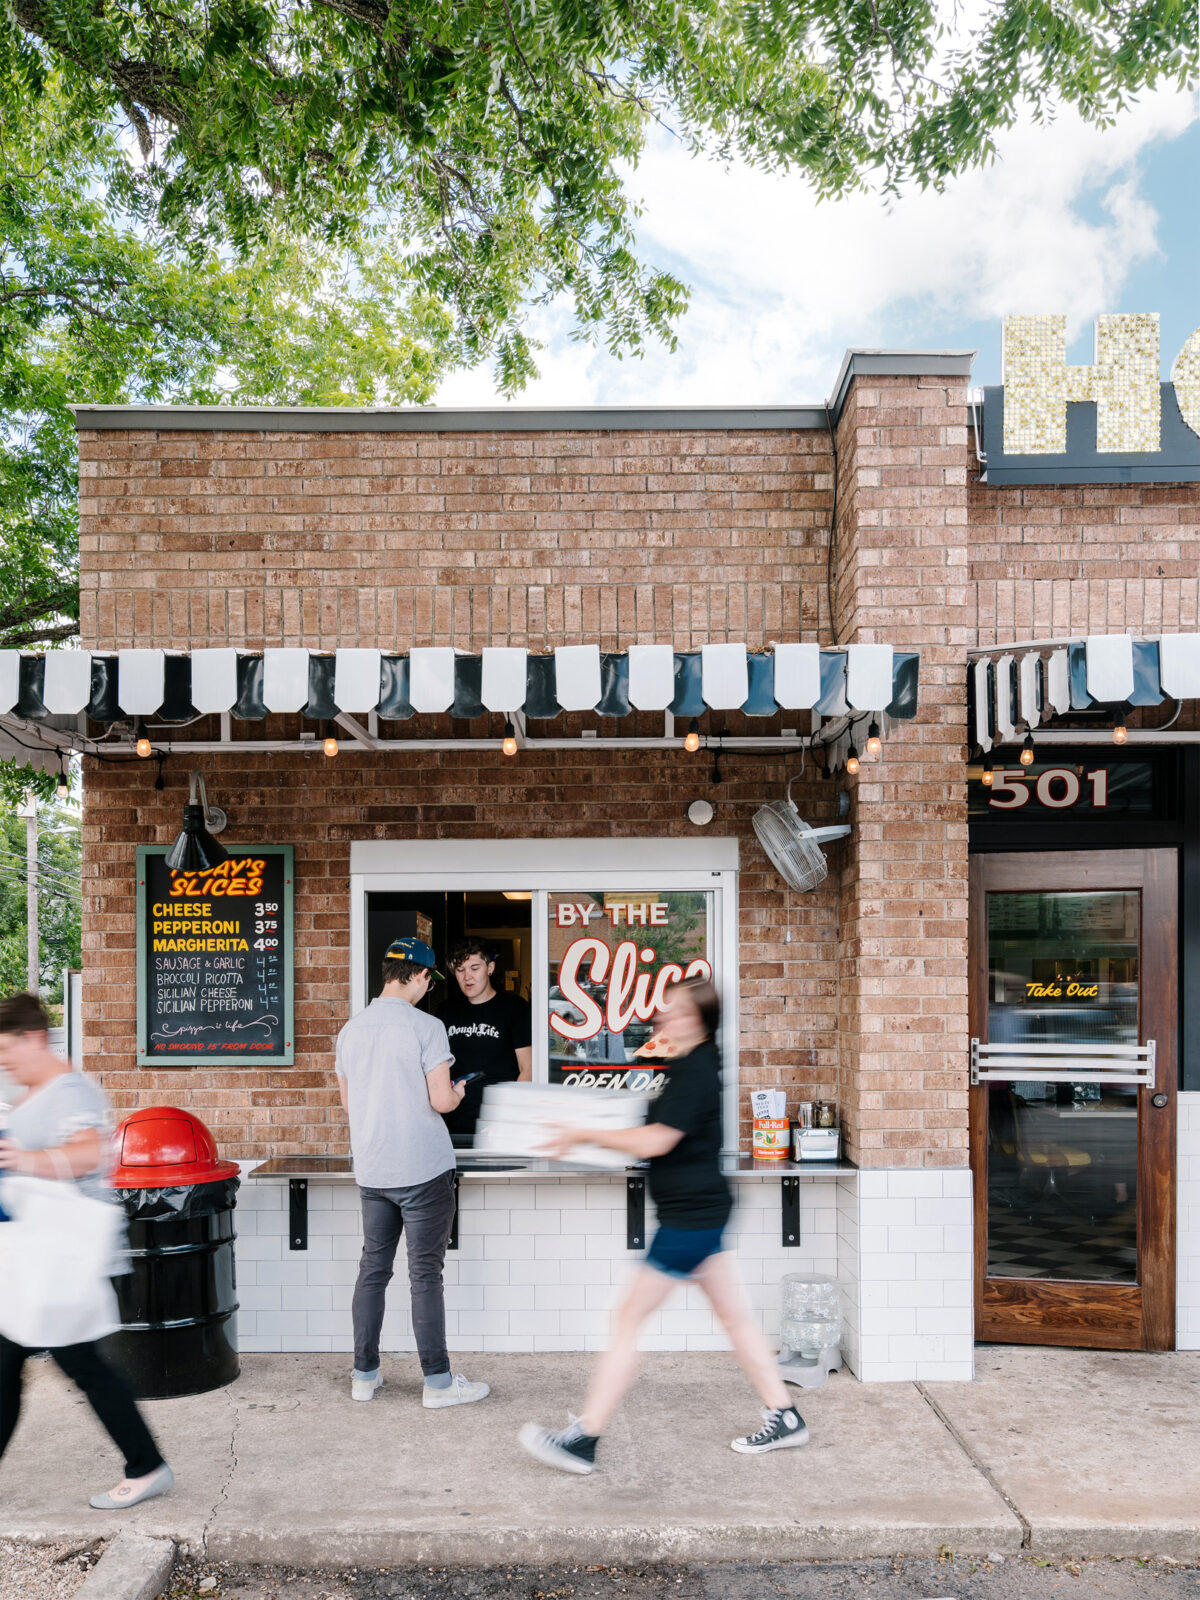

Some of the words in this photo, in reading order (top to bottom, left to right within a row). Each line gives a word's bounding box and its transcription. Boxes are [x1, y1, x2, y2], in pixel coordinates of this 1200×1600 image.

[1002, 312, 1200, 454] H
[988, 767, 1108, 808] 501
[170, 858, 266, 878] AY'S
[169, 878, 264, 896] SLICES
[152, 903, 212, 917] CHEESE
[556, 902, 596, 928] BY
[604, 901, 669, 927] THE
[153, 920, 240, 935] PEPPERONI
[153, 938, 250, 953] MARGHERITA
[155, 957, 201, 970] SAUSAGE
[204, 960, 211, 968] &
[213, 957, 246, 970] GARLIC
[156, 973, 200, 986] BROCCOLI
[205, 972, 244, 985] RICOTTA
[157, 986, 197, 1000] SICILIAN
[200, 987, 237, 999] CHEESE
[1026, 982, 1063, 997] Take
[1066, 982, 1099, 997] Out
[156, 999, 197, 1014] SICILIAN
[200, 998, 253, 1013] PEPPERONI
[225, 1019, 244, 1033] life
[154, 1042, 167, 1050] NO
[220, 1042, 247, 1050] FROM
[249, 1042, 274, 1051] DOOR
